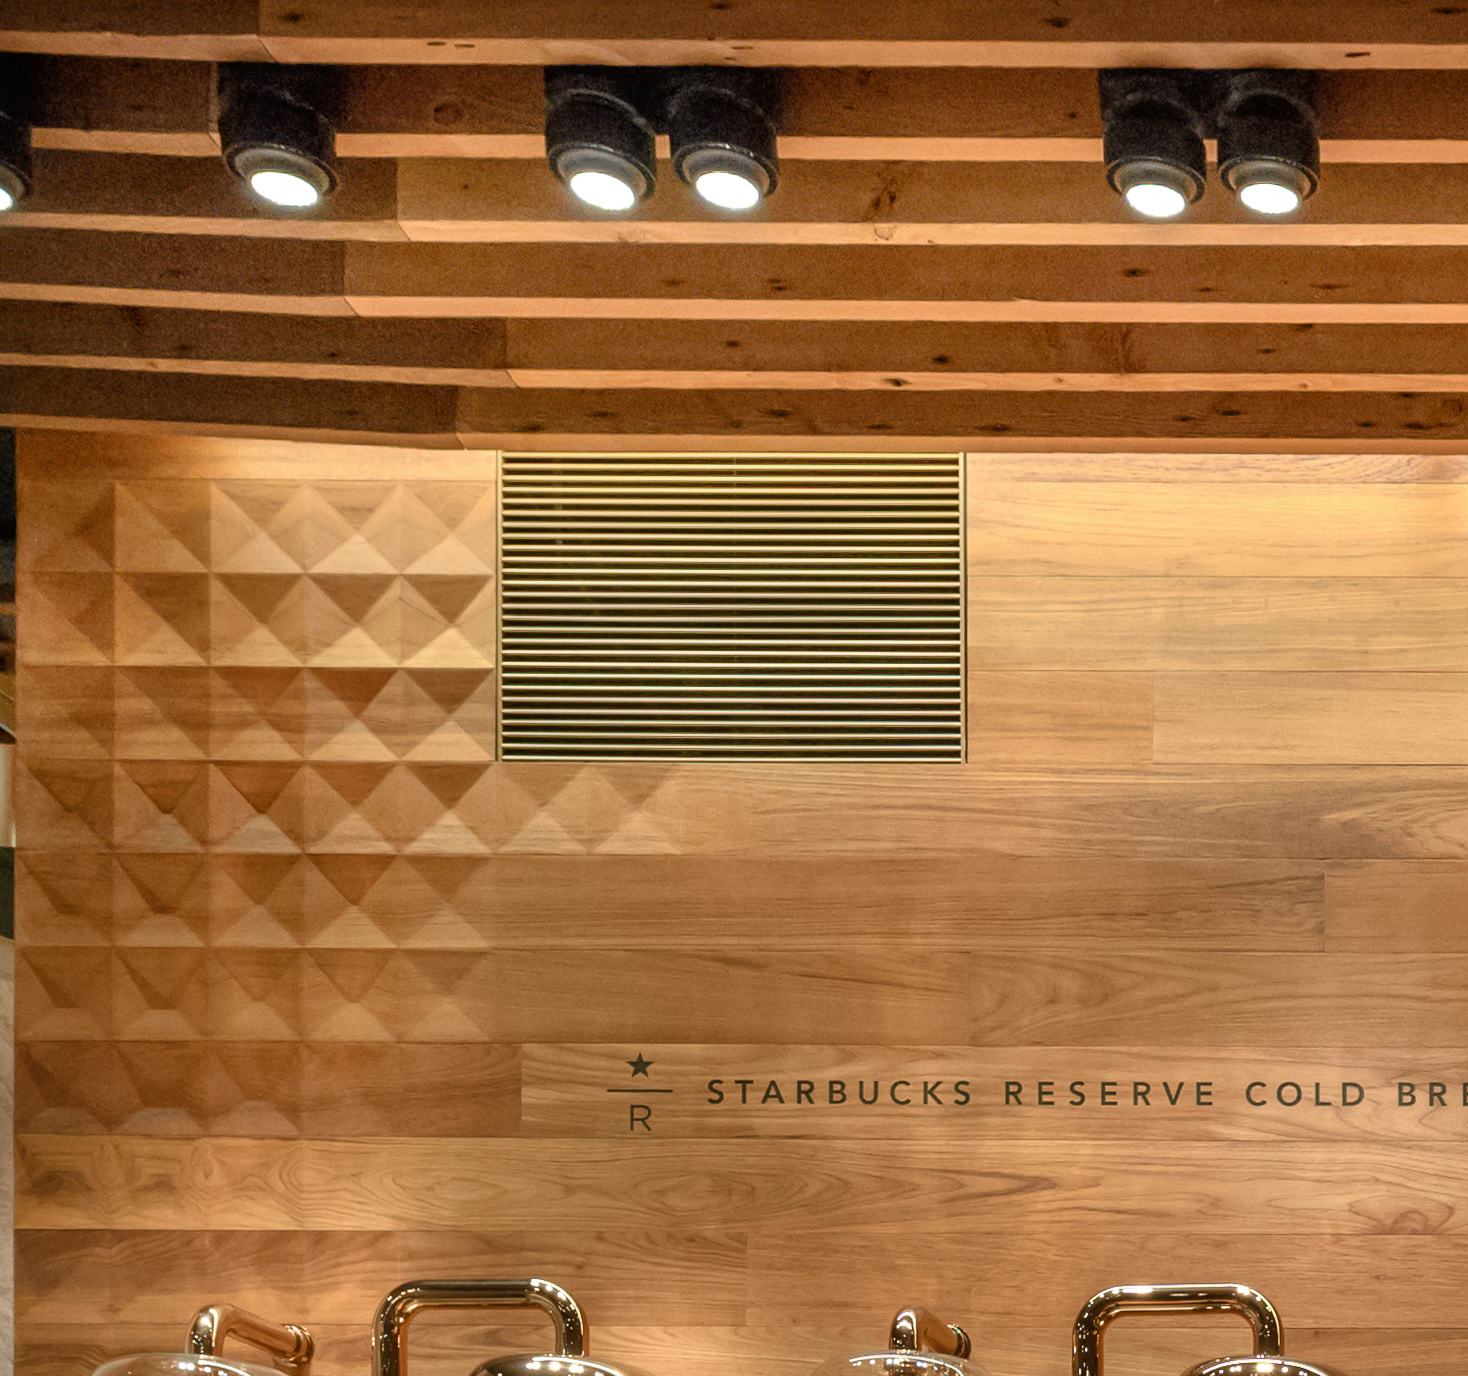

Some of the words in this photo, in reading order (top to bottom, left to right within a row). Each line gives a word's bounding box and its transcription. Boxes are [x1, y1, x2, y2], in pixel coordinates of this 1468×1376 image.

[706, 1079, 972, 1106] STARBUCKS
[1004, 1080, 1214, 1107] RESERVE
[1245, 1081, 1366, 1108] COLD
[629, 1104, 652, 1131] R
